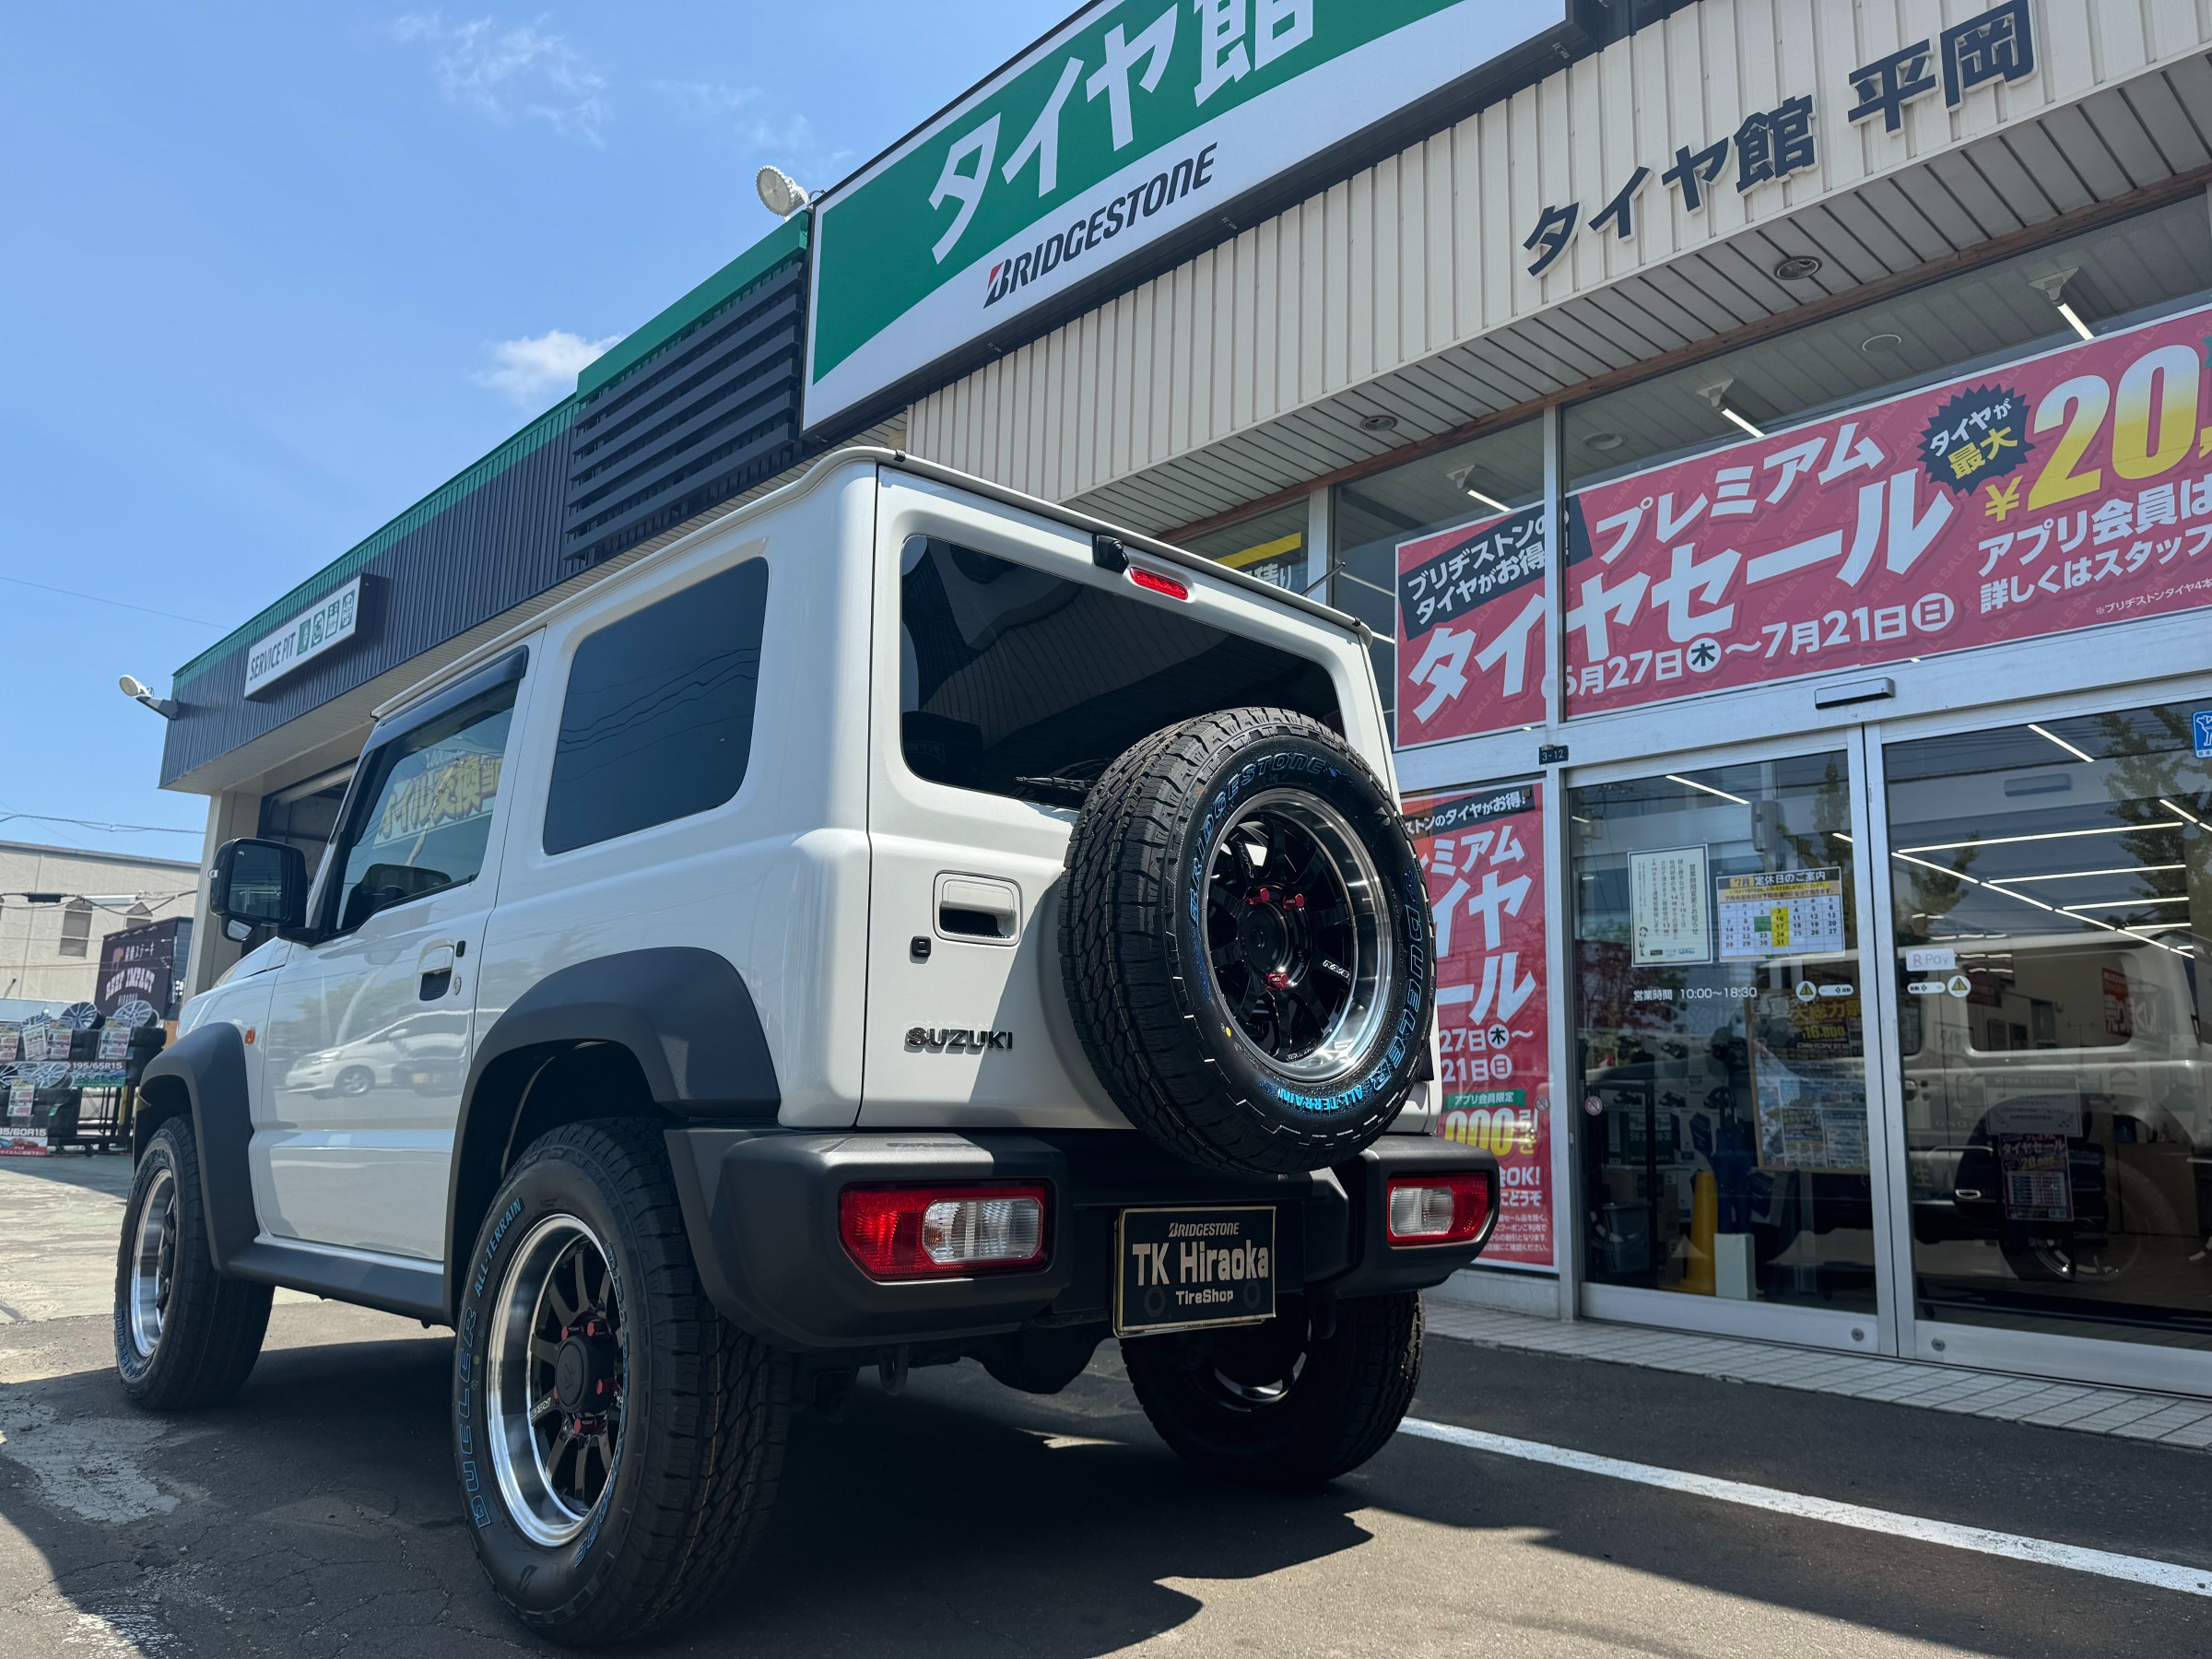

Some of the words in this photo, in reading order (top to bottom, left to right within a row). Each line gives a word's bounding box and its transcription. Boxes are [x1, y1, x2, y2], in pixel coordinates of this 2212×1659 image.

[929, 0, 1312, 265] タイヤ館
[1523, 95, 1818, 278] タイヤ館
[1847, 0, 2036, 136] 平岡
[983, 142, 1218, 309] BRIDGESTONE
[1930, 397, 2012, 457] タイヤが
[1947, 427, 2018, 479] 最大
[1596, 423, 1885, 564] プレミアム
[1407, 468, 1954, 724] タイヤセール
[249, 641, 282, 682] SERVICE
[281, 631, 296, 662] PIT
[1542, 748, 1565, 761] 3-12
[1188, 751, 1325, 926] BRIDGESTONE
[1421, 826, 1525, 877] ミアム
[1755, 871, 1826, 887] 定休日のご案内
[1432, 870, 1533, 959] イヤ
[105, 970, 125, 1002] BEEF
[125, 967, 156, 994] IMPACT
[1323, 959, 1350, 979] RAYS
[1925, 953, 1948, 966] Pay
[1370, 906, 1425, 1092] DUELER
[1633, 989, 1673, 1001] 営業時間
[907, 1027, 1013, 1050] SUZUKI
[73, 1062, 124, 1070] 195/65R15
[1454, 1091, 1514, 1106] アプリ会員限定
[1169, 1222, 1241, 1238] BRIDGESTONE
[1132, 1242, 1171, 1286] TK
[1180, 1240, 1269, 1284] Hiraoka
[1175, 1288, 1234, 1306] TireShop
[458, 1307, 493, 1529] DUELER
